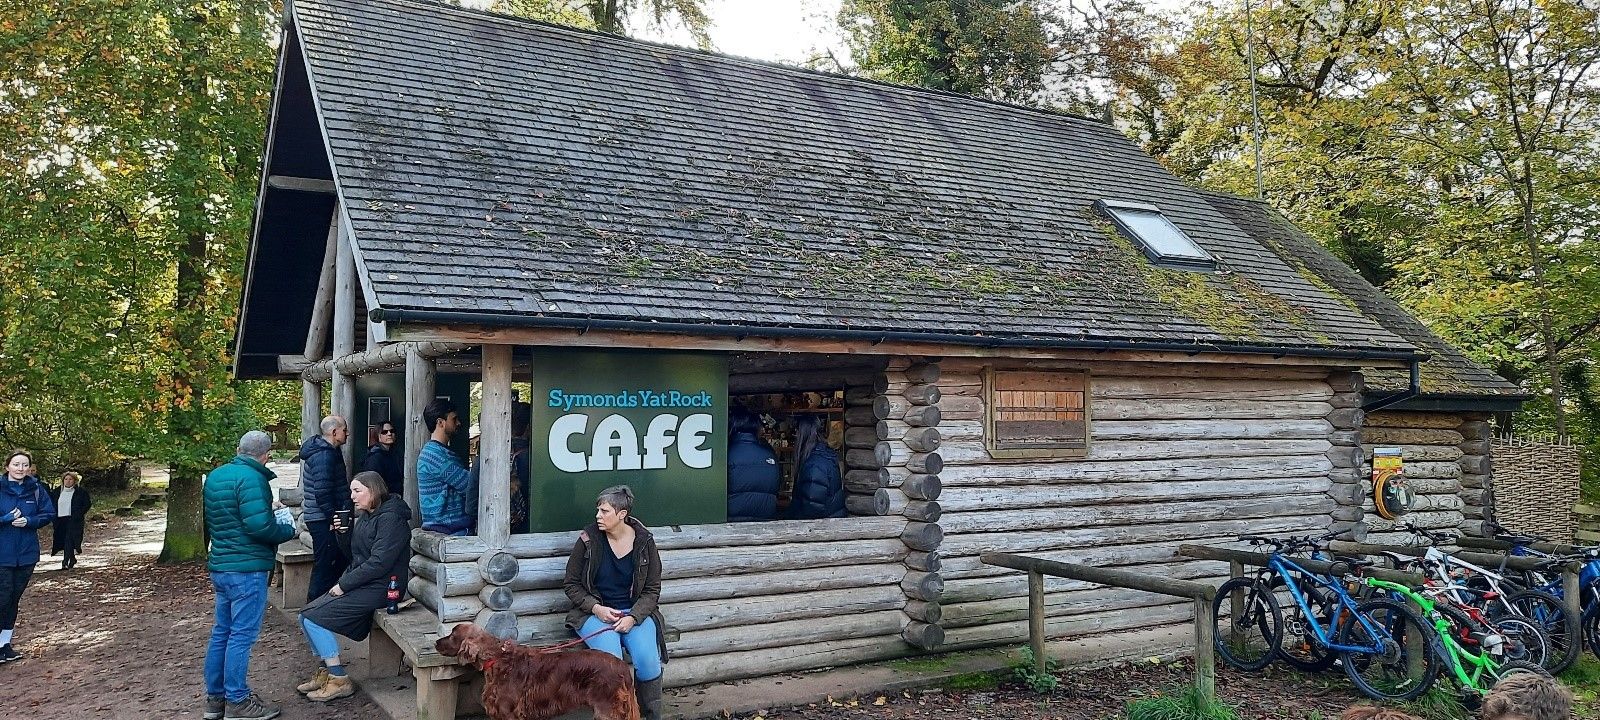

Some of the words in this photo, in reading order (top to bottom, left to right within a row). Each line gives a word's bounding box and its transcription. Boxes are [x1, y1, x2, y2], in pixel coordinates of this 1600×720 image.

[549, 389, 637, 411] Symonds
[638, 391, 669, 408] Yat
[669, 391, 712, 408] Rock
